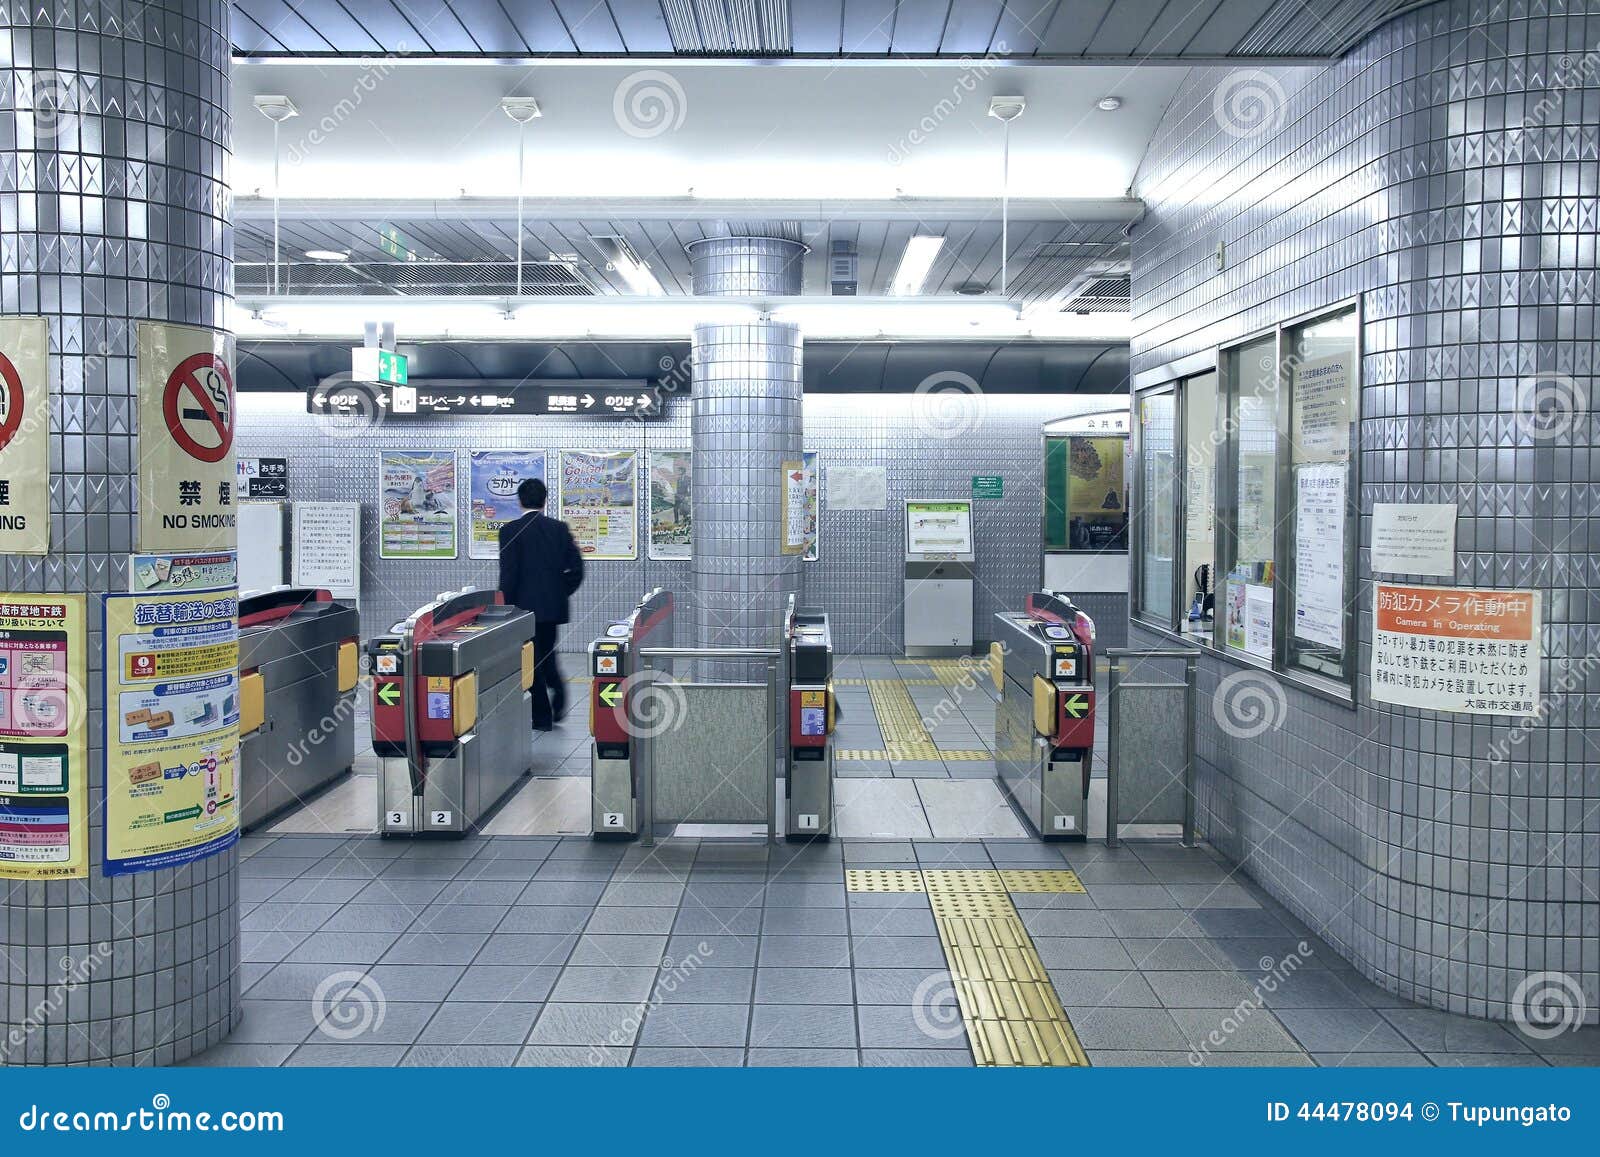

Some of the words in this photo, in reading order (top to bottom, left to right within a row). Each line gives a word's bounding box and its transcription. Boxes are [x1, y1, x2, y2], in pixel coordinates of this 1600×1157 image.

[330, 395, 358, 405] のりば
[419, 396, 466, 406] エレベータ
[605, 396, 634, 406] のりば
[251, 483, 286, 491] エレベータ
[163, 515, 187, 529] NO
[191, 515, 236, 528] SMOKING
[1379, 592, 1527, 617] 防犯カメラ作動中
[0, 605, 63, 616] 阪市営地下鉄
[1395, 616, 1427, 628] Camera
[1433, 620, 1442, 629] In
[1449, 620, 1501, 633] Operating
[1377, 651, 1528, 676] 安心して地下鉄をご利用いただくため
[1376, 669, 1533, 698] 駅構内に防犯カメラを設置しています。
[1465, 699, 1533, 711] 大阪市交通局
[393, 813, 402, 823] 3
[437, 813, 445, 823] 2
[609, 815, 617, 825] 2
